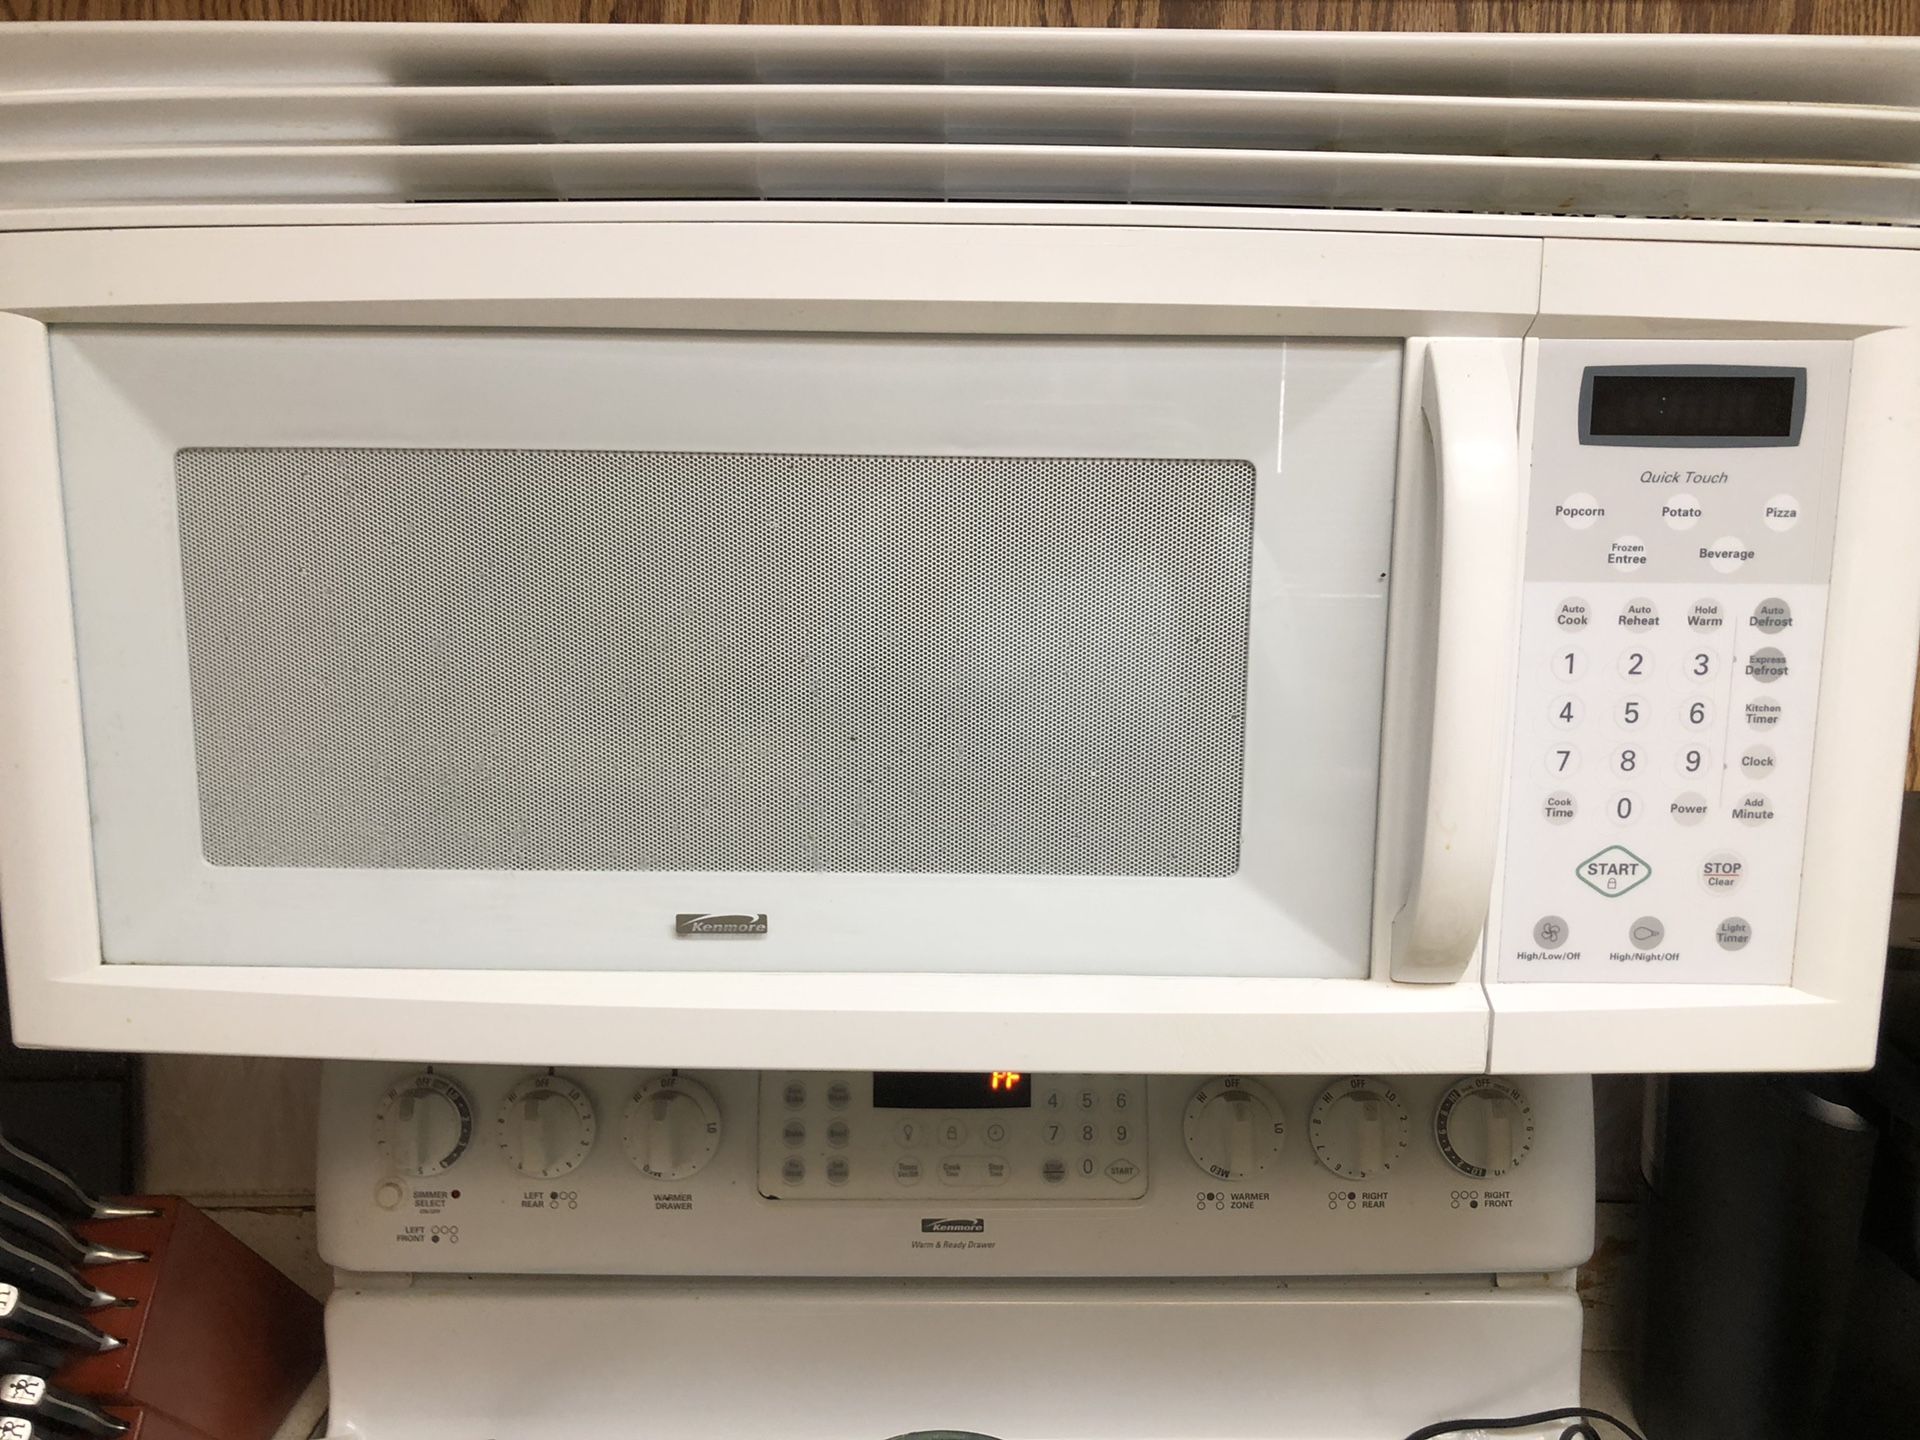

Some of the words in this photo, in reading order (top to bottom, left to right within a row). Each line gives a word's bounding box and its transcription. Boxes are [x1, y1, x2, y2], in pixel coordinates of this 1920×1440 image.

[1640, 471, 1680, 484] Quick
[1685, 471, 1728, 484] Touch
[1555, 506, 1605, 518] Popcorn
[1662, 507, 1702, 517] Potato
[1765, 507, 1797, 518] Pizza
[1612, 543, 1644, 552] Frozen
[1607, 554, 1647, 564] Entree
[1699, 548, 1755, 560] Beverage
[1562, 604, 1585, 614] Auto
[1628, 605, 1652, 614] Auto
[1695, 606, 1718, 614] Hold
[1761, 606, 1784, 615] Auto
[1557, 615, 1588, 625] Cook
[1618, 616, 1660, 626] Reheat
[1687, 616, 1723, 626] Warm
[1749, 617, 1793, 627] Defrost
[1564, 653, 1575, 674] 1
[1628, 653, 1643, 675] 2
[1693, 653, 1709, 675] 3
[1749, 655, 1786, 666] Express
[1745, 665, 1788, 676] Defrost
[1559, 702, 1573, 723] 4
[1624, 702, 1639, 723] 5
[1689, 702, 1705, 723] 6
[1745, 704, 1781, 713] Kitchen
[1746, 714, 1778, 724] Timer
[1556, 750, 1571, 771] 7
[1620, 750, 1636, 771] 8
[1686, 750, 1701, 772] 9
[1742, 756, 1773, 767] Clock
[1548, 798, 1572, 806] Cook
[1744, 799, 1764, 807] Add
[1545, 808, 1573, 818] Time
[1617, 798, 1632, 818] 0
[1670, 804, 1707, 814] Power
[1732, 809, 1774, 819] Minute
[1587, 863, 1639, 876] START
[1704, 863, 1742, 873] STOP
[1708, 877, 1734, 886] Clear
[692, 922, 766, 932] Kenmore
[1721, 924, 1746, 934] Light
[1717, 934, 1748, 943] Timer
[1517, 951, 1581, 961] High/Low/Off
[1609, 952, 1680, 961] High/Night/Off
[660, 1079, 676, 1087] OFF
[1224, 1079, 1240, 1087] OFF
[1350, 1080, 1365, 1088] OFF
[1475, 1079, 1491, 1087] OFF
[1048, 1093, 1057, 1107] 4
[1083, 1093, 1092, 1107] 5
[1196, 1092, 1207, 1103] HI
[1322, 1092, 1334, 1103] HI
[1385, 1089, 1396, 1101] LO
[1117, 1093, 1126, 1108] 6
[1050, 1126, 1059, 1140] 7
[1083, 1126, 1092, 1140] 8
[1117, 1126, 1126, 1140] 9
[1274, 1123, 1283, 1134] LO
[1083, 1159, 1093, 1174] 0
[1209, 1165, 1230, 1178] MED
[413, 1191, 447, 1199] SIMMER
[1231, 1192, 1270, 1200] WARMER
[1362, 1192, 1388, 1200] RIGHT
[1484, 1191, 1510, 1199] RIGHT
[655, 1202, 693, 1210] DRAWER
[1231, 1201, 1254, 1209] ZONE
[1362, 1200, 1385, 1208] REAR
[1484, 1199, 1513, 1208] FRONT
[405, 1226, 424, 1234] LEFT
[397, 1234, 425, 1242] FRONT
[943, 1241, 966, 1250] Ready
